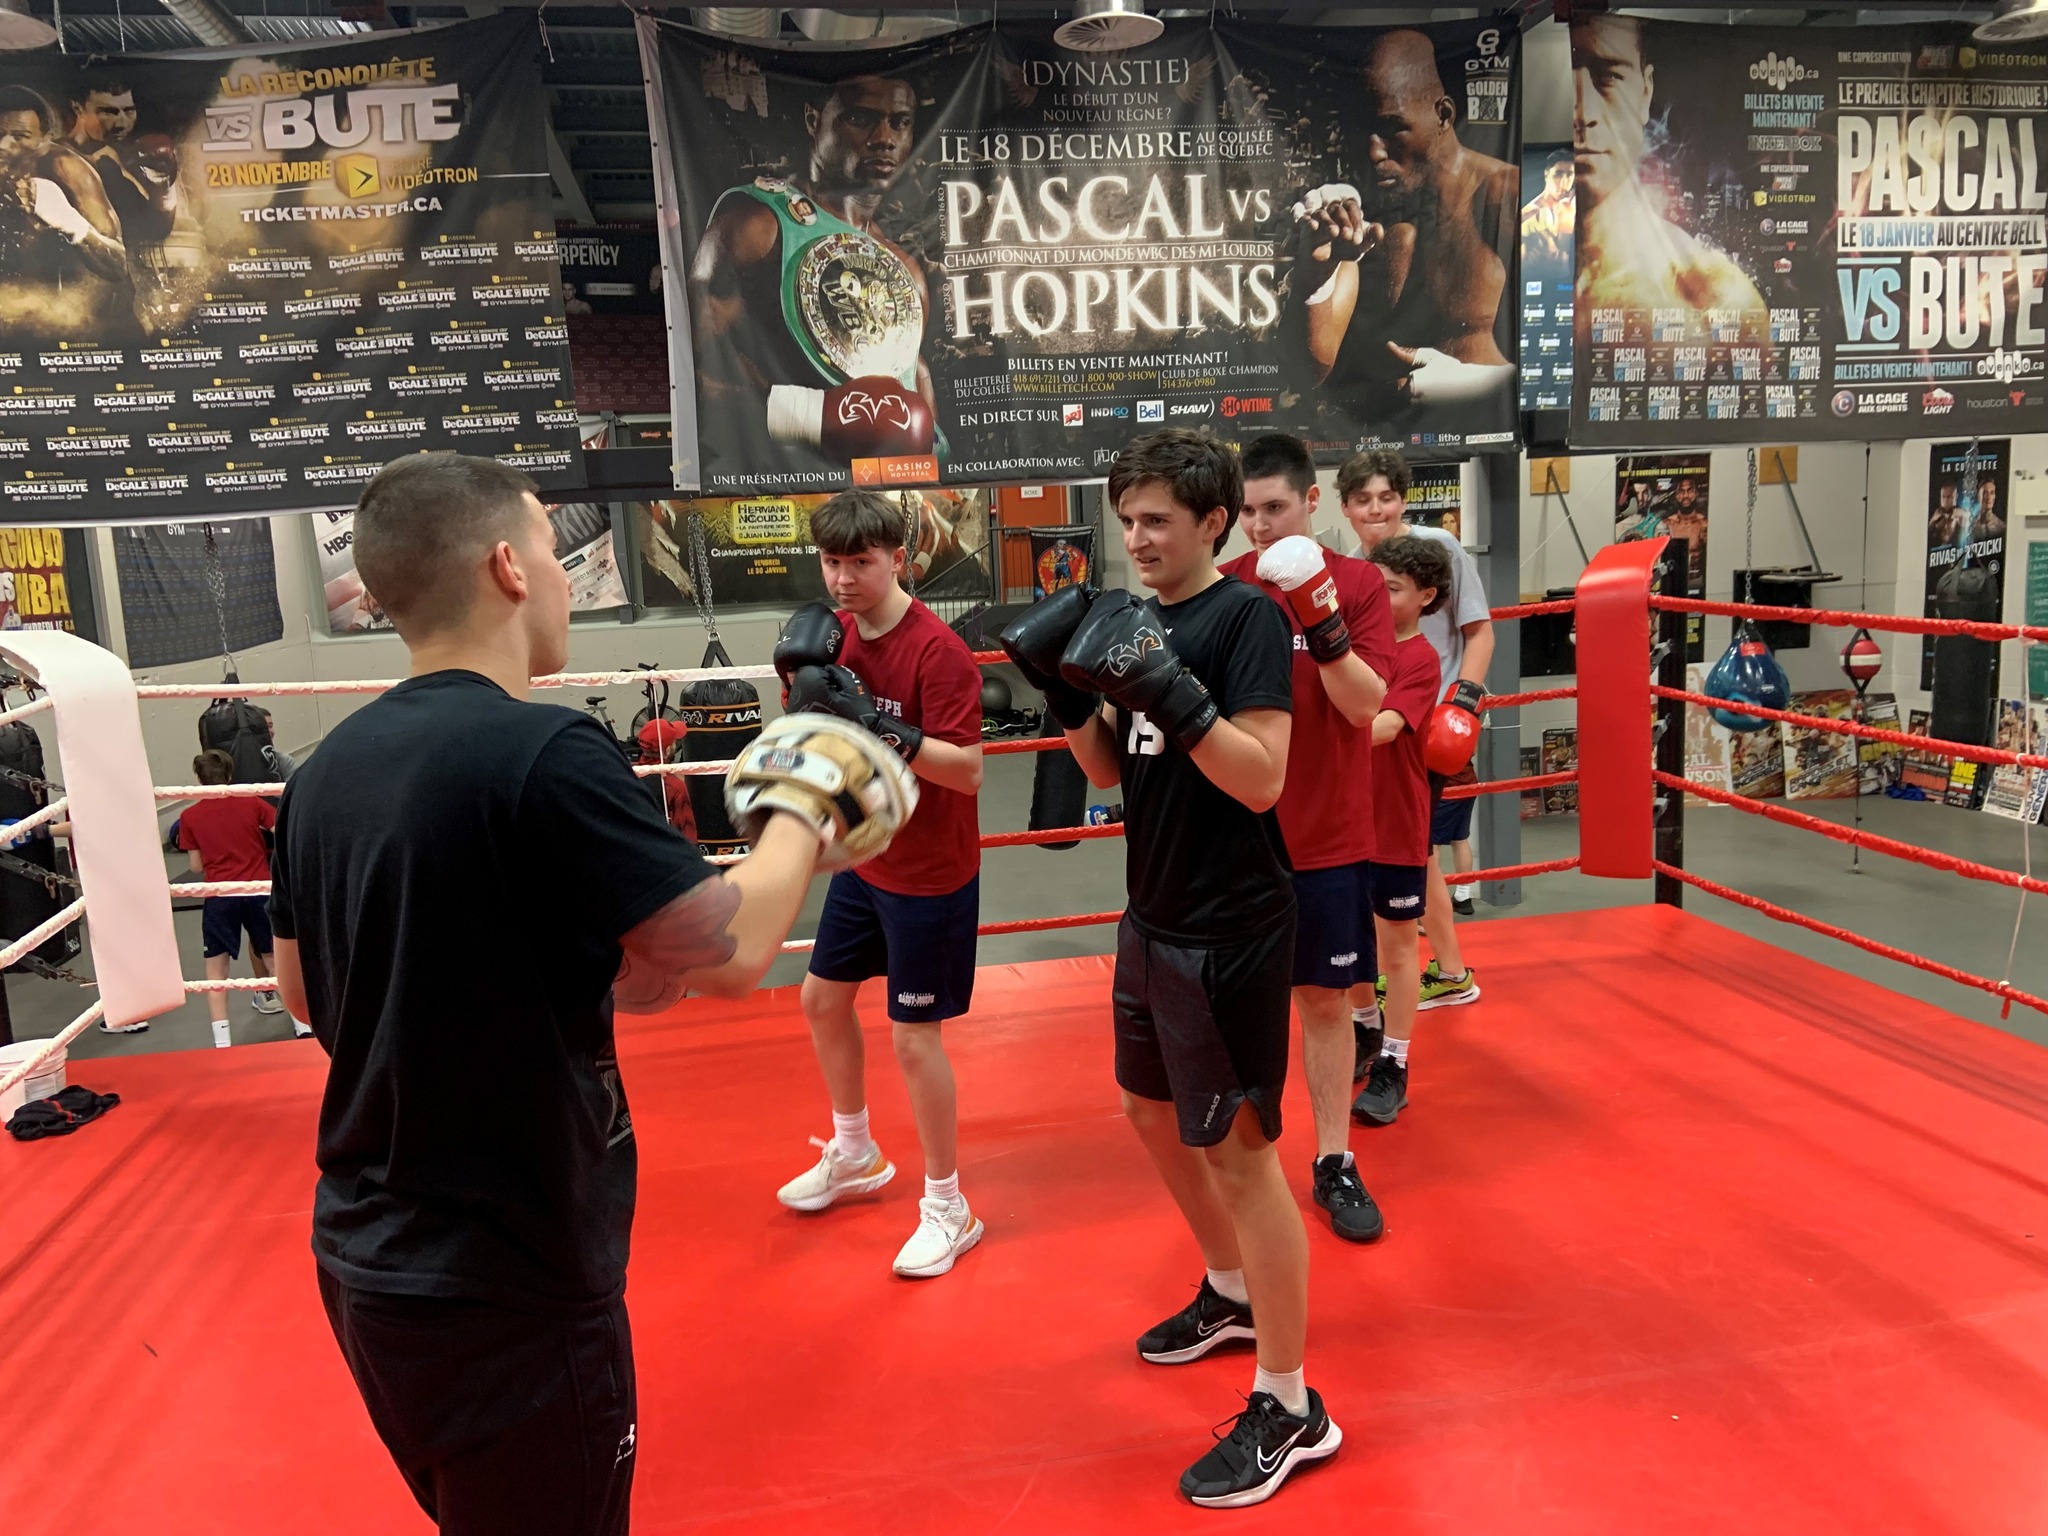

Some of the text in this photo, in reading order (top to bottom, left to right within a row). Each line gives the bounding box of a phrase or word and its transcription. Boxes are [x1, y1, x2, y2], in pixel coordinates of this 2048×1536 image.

[1464, 56, 1510, 71] GYM
[1838, 51, 1851, 63] UNE
[1979, 52, 2047, 65] VIDÉOTRON
[220, 56, 436, 98] LA RECONQUÊTE
[1750, 54, 1819, 88] evenko.ca
[1466, 81, 1508, 96] GOLDEN
[1838, 82, 1853, 104] LE
[1856, 82, 1909, 105] PREMIER
[1911, 81, 1971, 106] CHAPITRE
[1054, 90, 1159, 107] LE DÉBUT D'UN
[1744, 94, 1824, 110] BILLETS EN VENTE
[205, 84, 463, 149] VS BUTE
[1044, 105, 1171, 122] NOUVEAU RÈGNE?
[1196, 127, 1273, 144] AU COLISÉE
[939, 128, 1192, 164] LE 18 DÉCEMBRE
[1198, 141, 1273, 157] DE QUÉBEC
[1837, 115, 2048, 212] PASCAL
[207, 160, 332, 187] 28 NOVEMBRE
[385, 167, 478, 190] VIDÉOTRON
[1769, 194, 1816, 202] VIDÉOTRON
[240, 197, 442, 222] TICKETMASTER.CA
[942, 174, 1271, 246] PASCAL VS
[1841, 220, 2042, 247] LE 18 JANVIER AU CENTRE BELL
[944, 243, 1274, 268] CHAMPIONNAT DU MONDE WBC DES MI-LOURDS
[228, 261, 312, 272] DeGALE BUTE
[946, 265, 1277, 338] HOPKINS
[1837, 253, 2048, 350] VS BUTE
[1592, 309, 1624, 323] PASCAL
[431, 332, 509, 345] DeGALE BUTE
[1602, 329, 1624, 343] BUTE
[40, 355, 123, 366] DeGALE BUTE
[1008, 351, 1228, 371] BILLETS EN VENTE MAINTENANT!
[1614, 348, 1646, 362] PASCAL
[1790, 347, 1821, 360] PASCAL
[954, 374, 1010, 388] BILLETTERIE
[1013, 374, 1027, 383] 418
[1063, 374, 1078, 383] OU
[1088, 372, 1104, 382] 800
[1108, 371, 1157, 381] 900-SHOW
[1162, 365, 1279, 379] CLUB DE BOXE CHAMPION
[1624, 368, 1646, 382] BUTE
[1799, 366, 1820, 380] BUTE
[1834, 363, 1871, 381] BILLETS
[1871, 364, 1883, 379] EN
[1884, 363, 1912, 379] VENTE
[956, 383, 1115, 398] DU COLISÉE WWW.BILLETECH.COM
[1163, 377, 1216, 389] 514 376-0980
[1859, 393, 1876, 405] LA
[1877, 392, 1908, 404] CAGE
[1967, 398, 2008, 409] houston
[1091, 407, 1129, 418] INDIGO
[1139, 404, 1162, 419] Bell
[1170, 404, 1210, 414] SHAW
[1220, 397, 1273, 417] SHOWTIME
[1858, 405, 1908, 413] AUX SPORTS
[1923, 406, 1953, 415] LIGHT
[443, 416, 520, 428] DeGALE BUTE
[960, 414, 978, 426] EN
[983, 410, 1033, 424] DIRECT
[1037, 410, 1059, 421] SUR
[1356, 440, 1404, 452] groupimage
[1361, 435, 1381, 444] tonik
[887, 461, 931, 472] CASINO
[948, 458, 1084, 473] EN COLLABORATION AVEC:
[1942, 460, 1998, 472] LA COUÊTE
[713, 471, 845, 486] UNE PRÉSENTATION DU
[890, 469, 930, 478] MONTRÉAL
[1426, 487, 1443, 502] LES
[738, 504, 789, 515] HERMANN
[739, 514, 790, 523] NGOUDJO
[167, 524, 185, 536] GYM
[711, 548, 765, 557] CHAMPIONNAT
[775, 546, 803, 555] MONDE
[1929, 548, 1956, 568] RIVAS
